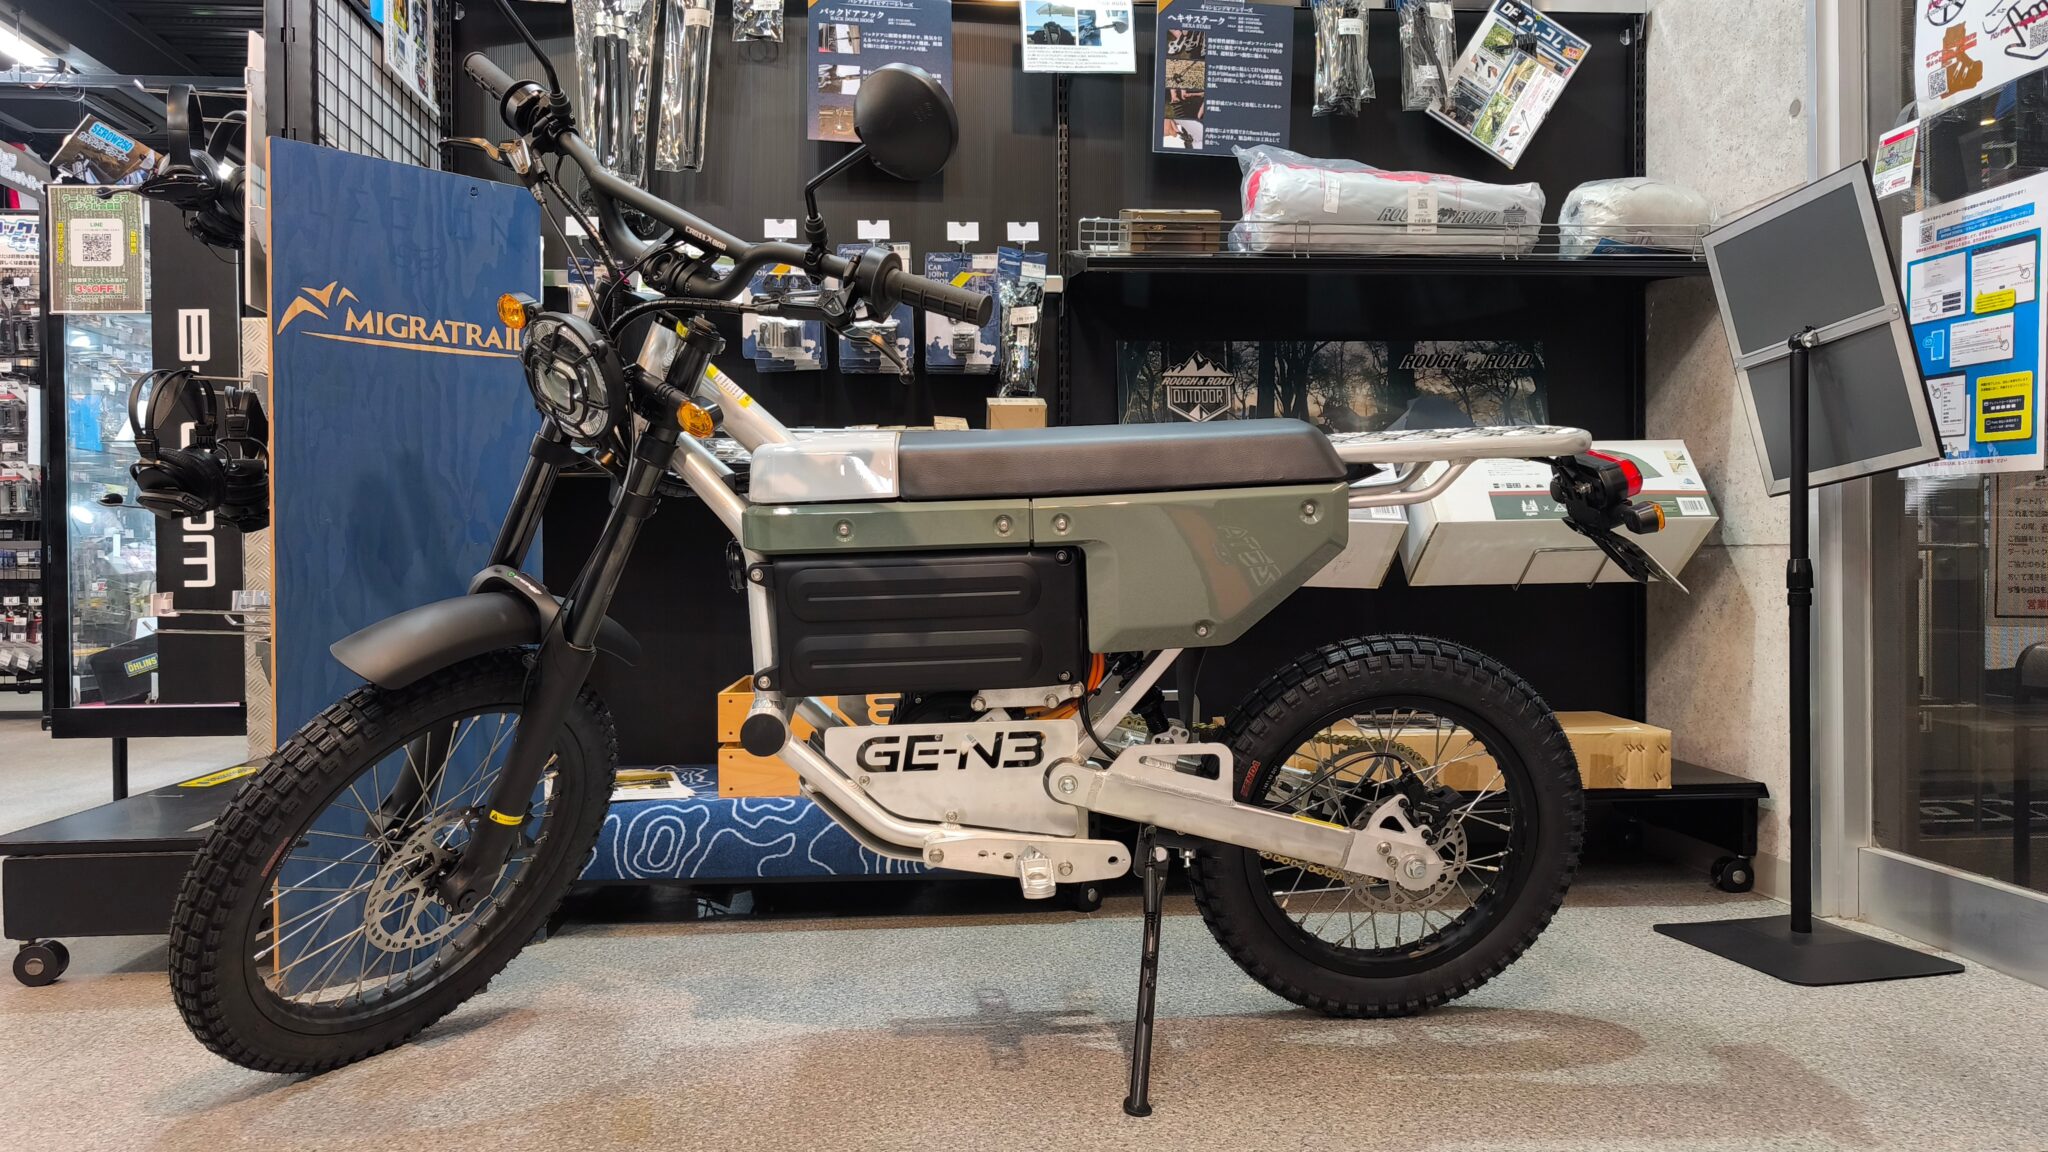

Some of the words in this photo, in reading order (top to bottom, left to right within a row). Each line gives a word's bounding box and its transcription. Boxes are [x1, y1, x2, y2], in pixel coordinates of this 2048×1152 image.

[818, 8, 885, 19] バックドアフック
[1167, 13, 1226, 26] ヘキサステーク
[91, 123, 134, 152] SEROW250
[684, 225, 707, 241] CROSS
[711, 239, 727, 252] BAR
[1399, 354, 1462, 369] ROUGH
[1481, 353, 1533, 369] ROAD
[1173, 389, 1224, 404] OUTDOOR
[856, 731, 1046, 773] GE-N3
